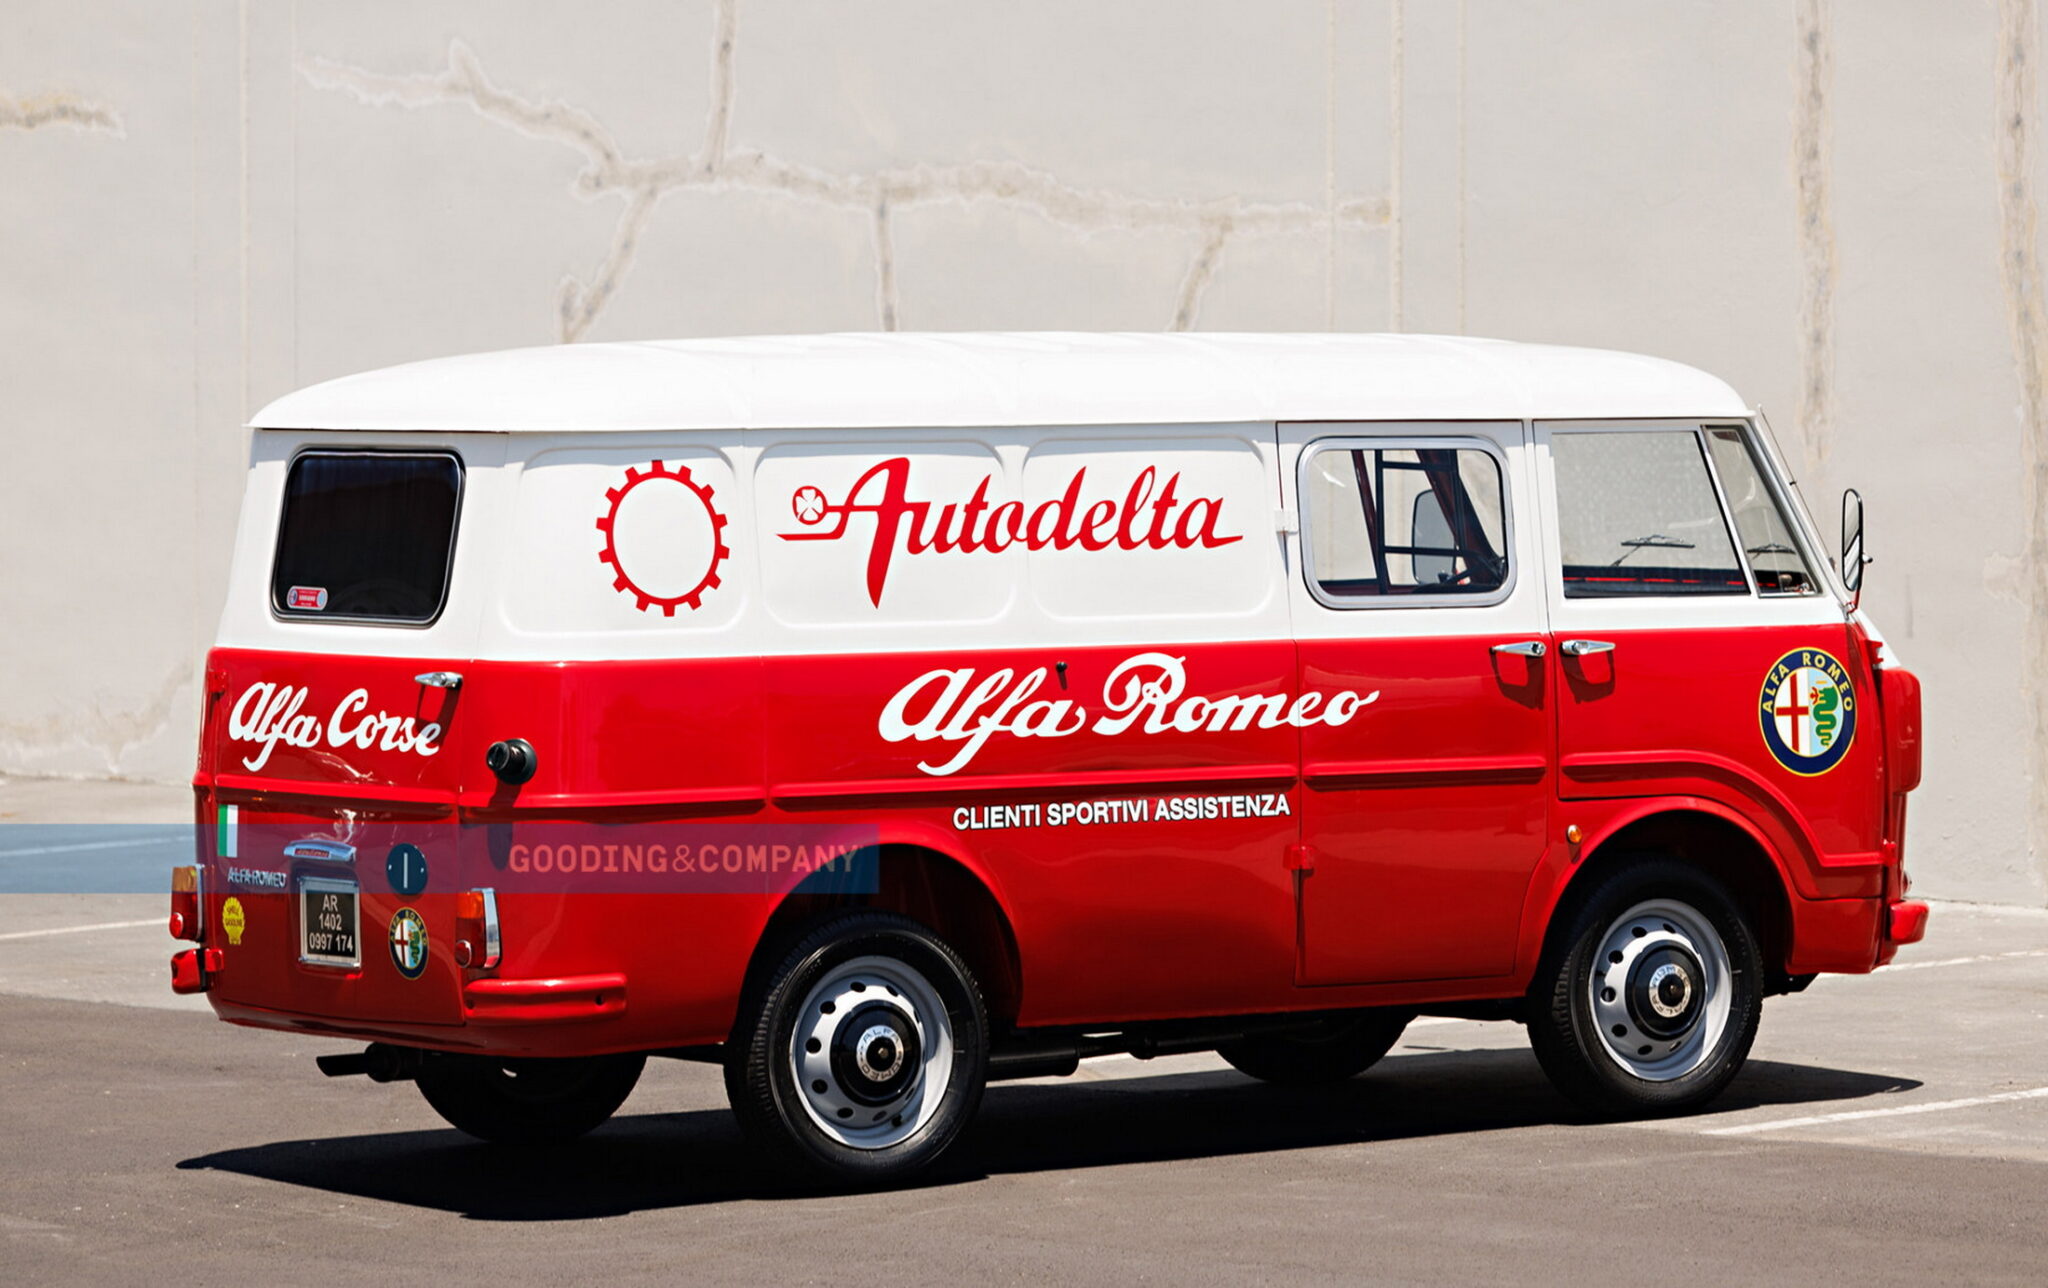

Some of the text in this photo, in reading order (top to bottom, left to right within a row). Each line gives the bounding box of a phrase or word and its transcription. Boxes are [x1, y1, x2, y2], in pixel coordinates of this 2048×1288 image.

[777, 457, 1243, 609] Autodelta
[1762, 652, 1853, 713] ALFA ROMEO
[229, 681, 441, 772] Alfa Corse
[879, 652, 1380, 776] Alfa Romeo
[953, 794, 1291, 830] CLIENTI SPORTIVI ASSISTENZA
[319, 913, 342, 931] 1402
[322, 894, 338, 912] AR
[309, 933, 353, 952] 0997 174
